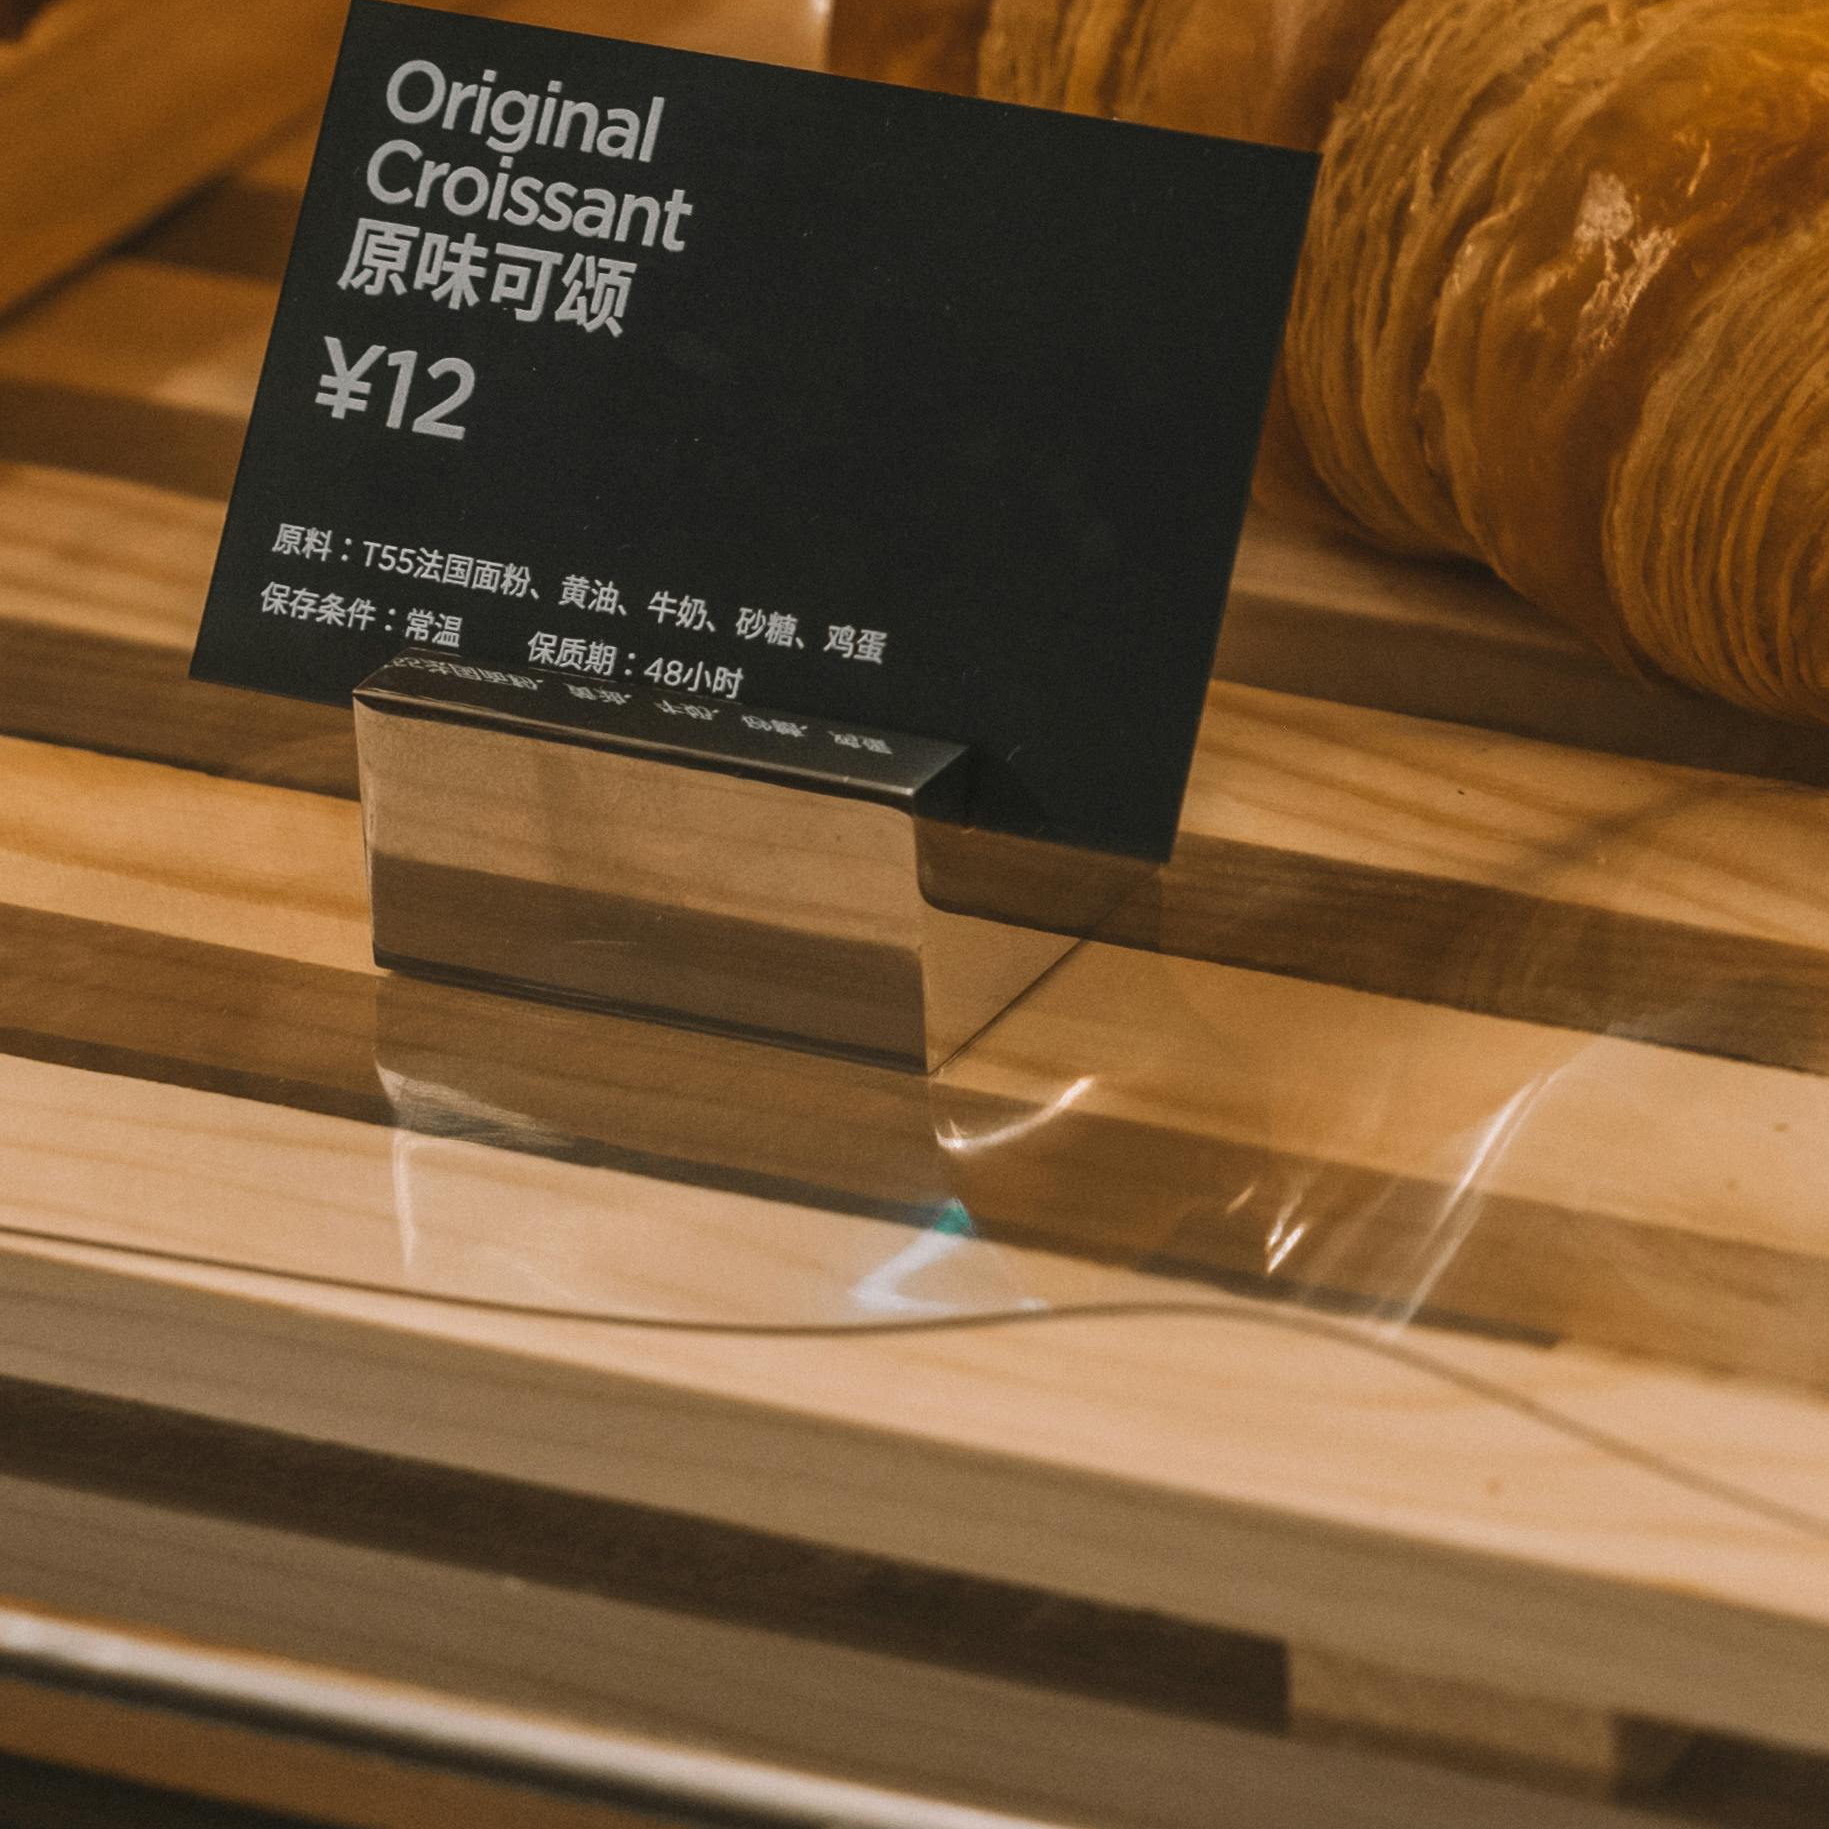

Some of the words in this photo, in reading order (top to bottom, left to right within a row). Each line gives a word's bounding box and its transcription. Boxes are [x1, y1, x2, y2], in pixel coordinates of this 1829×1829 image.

[386, 60, 665, 162] Original
[367, 139, 693, 252] Croissant
[337, 217, 637, 337] 原味可颂
[315, 336, 475, 440] ¥12
